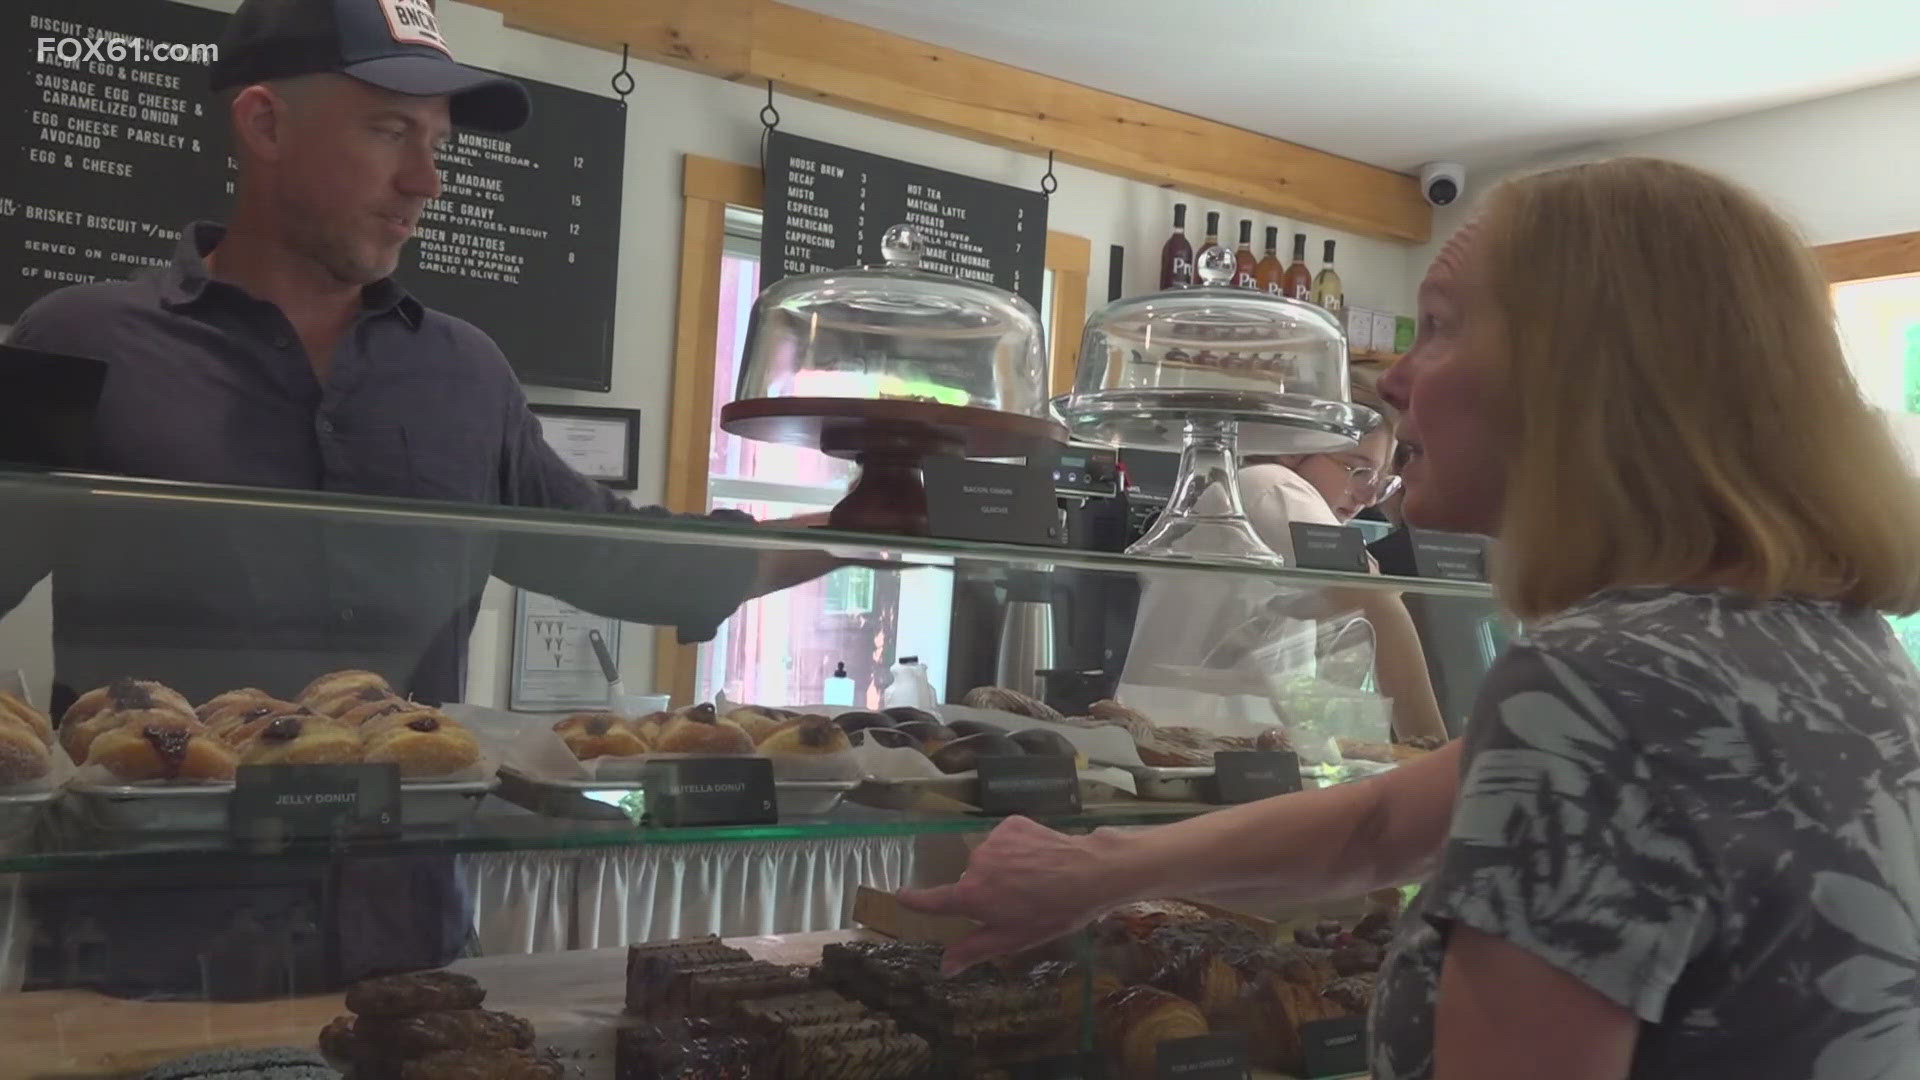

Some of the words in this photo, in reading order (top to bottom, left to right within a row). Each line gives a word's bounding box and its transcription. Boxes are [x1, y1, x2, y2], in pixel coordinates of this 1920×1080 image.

[31, 15, 82, 37] BISCUIT
[87, 27, 154, 52] SANDWCH
[37, 53, 80, 71] ACON
[89, 61, 114, 77] EGG
[118, 67, 127, 81] &
[131, 69, 181, 90] CHEESE
[35, 73, 96, 97] SAUSAGE
[105, 86, 129, 102] EGG
[138, 92, 187, 113] CHEESE
[195, 104, 203, 116] &
[43, 90, 137, 119] CARAMELIZED
[141, 108, 179, 126] ONION
[32, 110, 59, 127] EGG
[67, 117, 119, 138] CHEESE
[127, 128, 185, 149] PARSLEY
[192, 139, 201, 152] &
[40, 128, 101, 149] AVOCADO
[458, 133, 512, 153] MONSIEUR
[30, 149, 56, 165] EGG
[64, 155, 73, 168] &
[82, 157, 133, 178] CHEESE
[433, 152, 474, 167] CHAMEL
[574, 156, 584, 168] 12
[485, 151, 530, 168] CHEDDAR
[456, 172, 503, 192] MADAME
[820, 163, 845, 179] BREW
[861, 173, 867, 184] 3
[441, 184, 472, 197] SIEUR
[485, 192, 505, 202] EGG
[788, 171, 815, 186] DECAF
[860, 188, 866, 198] 3
[907, 184, 922, 196] HOT
[927, 188, 941, 200] TEA
[424, 198, 454, 214] SAGE
[460, 203, 494, 220] GRAVY
[571, 195, 581, 206] 15
[787, 186, 815, 201] MISTO
[860, 202, 865, 212] 4
[906, 198, 938, 213] MATCHA
[942, 206, 966, 220] LATTE
[26, 206, 82, 226] BRISKET
[87, 215, 136, 234] BISCUIT
[787, 201, 829, 219] ESPRESSO
[905, 212, 945, 228] AFFOGATO
[509, 225, 549, 240] BISCUIT
[569, 224, 580, 236] 12
[786, 215, 834, 234] AMERICANO
[412, 226, 446, 242] ARDEN
[452, 232, 505, 252] POTATOES
[785, 230, 836, 249] CAPPUCCINO
[25, 240, 76, 256] SERVED
[85, 249, 102, 259] ON
[111, 252, 173, 269] CROISSAN
[420, 241, 469, 256] ROASTED
[471, 250, 525, 265] POTATOES
[568, 252, 575, 263] 8
[784, 244, 811, 259] LATTE
[926, 247, 947, 261] MADE
[951, 252, 990, 269] LEMONADE
[419, 261, 457, 275] GARLIC
[470, 269, 500, 282] OLIVE
[503, 274, 519, 284] OIL
[420, 251, 461, 266] TOSSED
[464, 257, 475, 267] IN
[477, 260, 521, 274] PAPRIKA
[783, 259, 805, 273] COLD
[918, 259, 953, 275] AWBERRY
[955, 266, 995, 283] LEMONADE
[44, 270, 95, 285] BISCUIT
[714, 783, 745, 793] DONUT
[275, 794, 312, 805] JELLY
[315, 793, 357, 804] DONUT
[381, 813, 390, 824] 5
